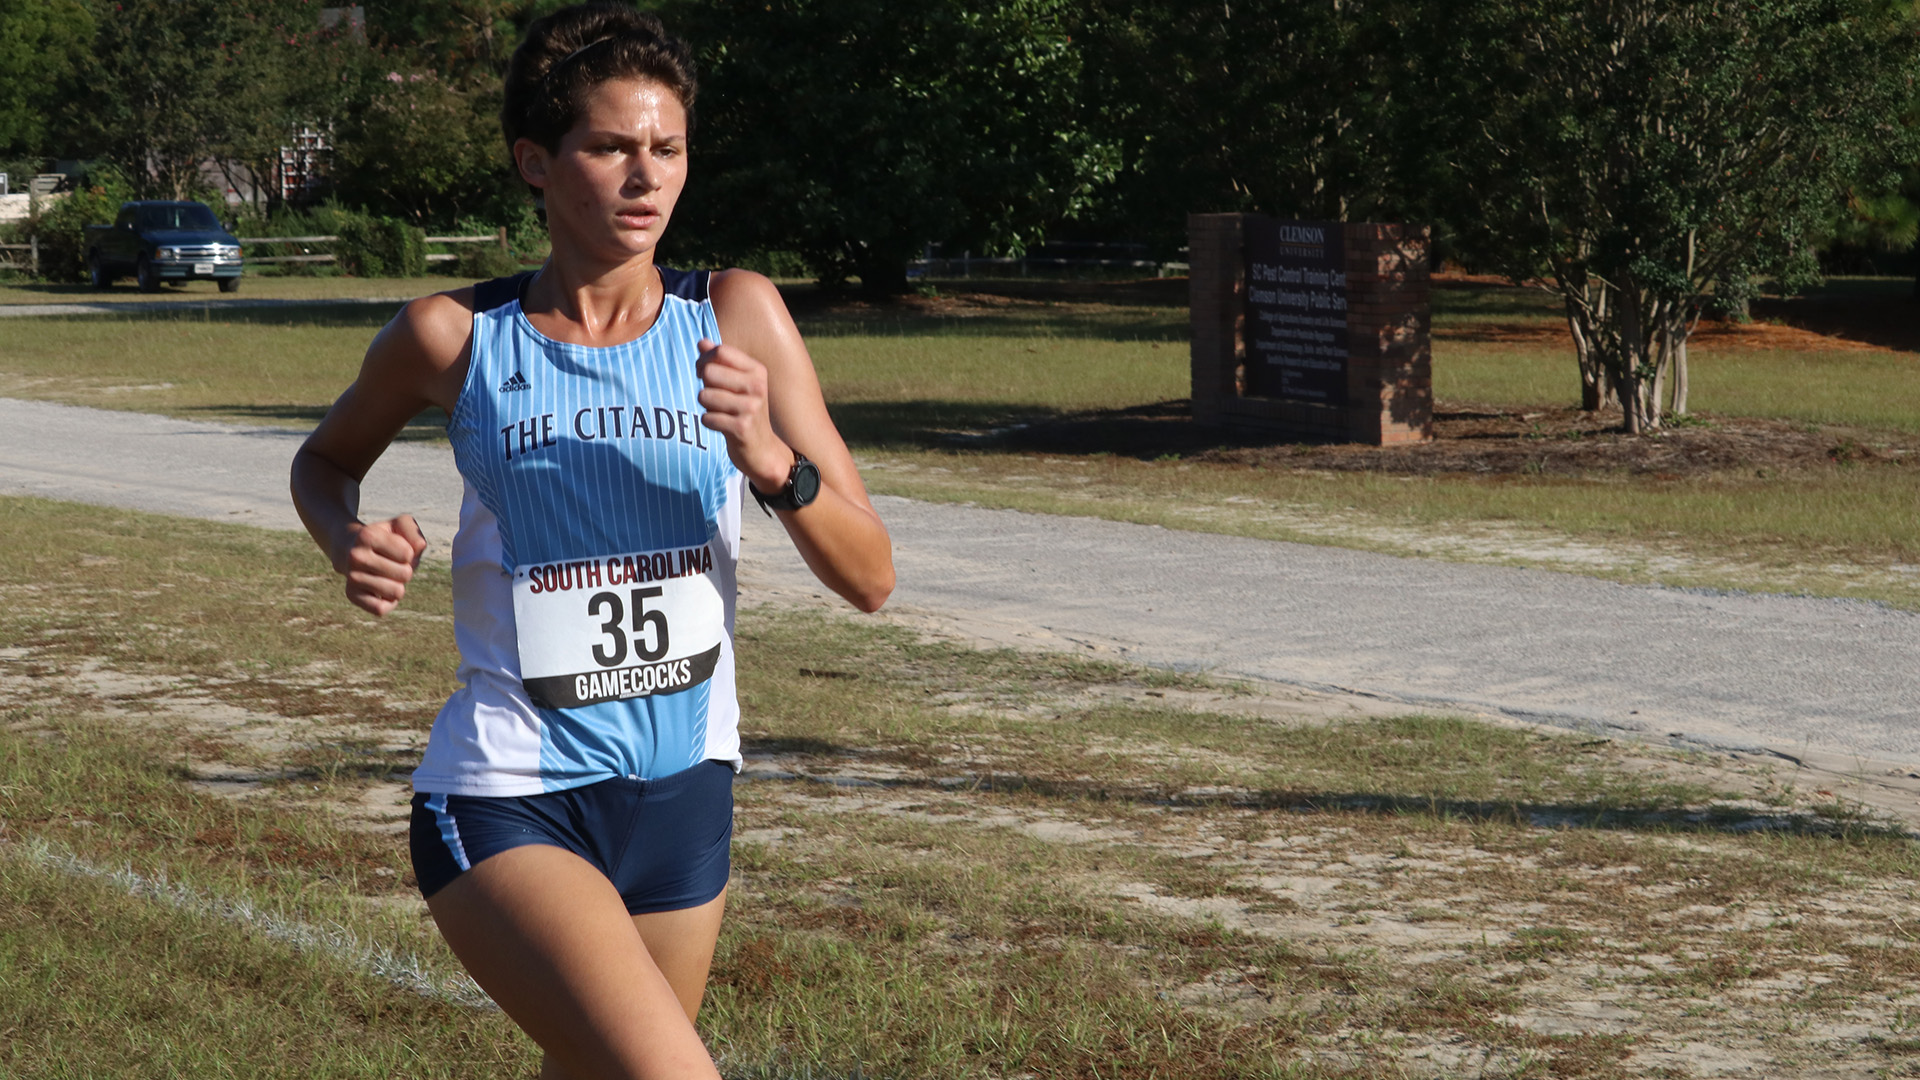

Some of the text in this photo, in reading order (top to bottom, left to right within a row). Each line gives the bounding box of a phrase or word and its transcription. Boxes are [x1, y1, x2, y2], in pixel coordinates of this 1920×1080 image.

[1280, 226, 1324, 243] CLEMSON
[1280, 246, 1324, 258] UNIVERSITY
[1252, 263, 1262, 280] SC
[1263, 264, 1277, 281] Pest
[1278, 265, 1302, 283] Control
[1303, 267, 1329, 290] Training
[1249, 286, 1276, 303] Clemson
[1277, 288, 1309, 311] University
[1310, 290, 1331, 309] Public
[499, 383, 531, 392] adidas
[500, 406, 707, 462] THE CITADEL
[528, 545, 713, 594] SOUTH CAROLINA
[587, 585, 670, 668] 35
[575, 659, 692, 701] GAMECOCKS
